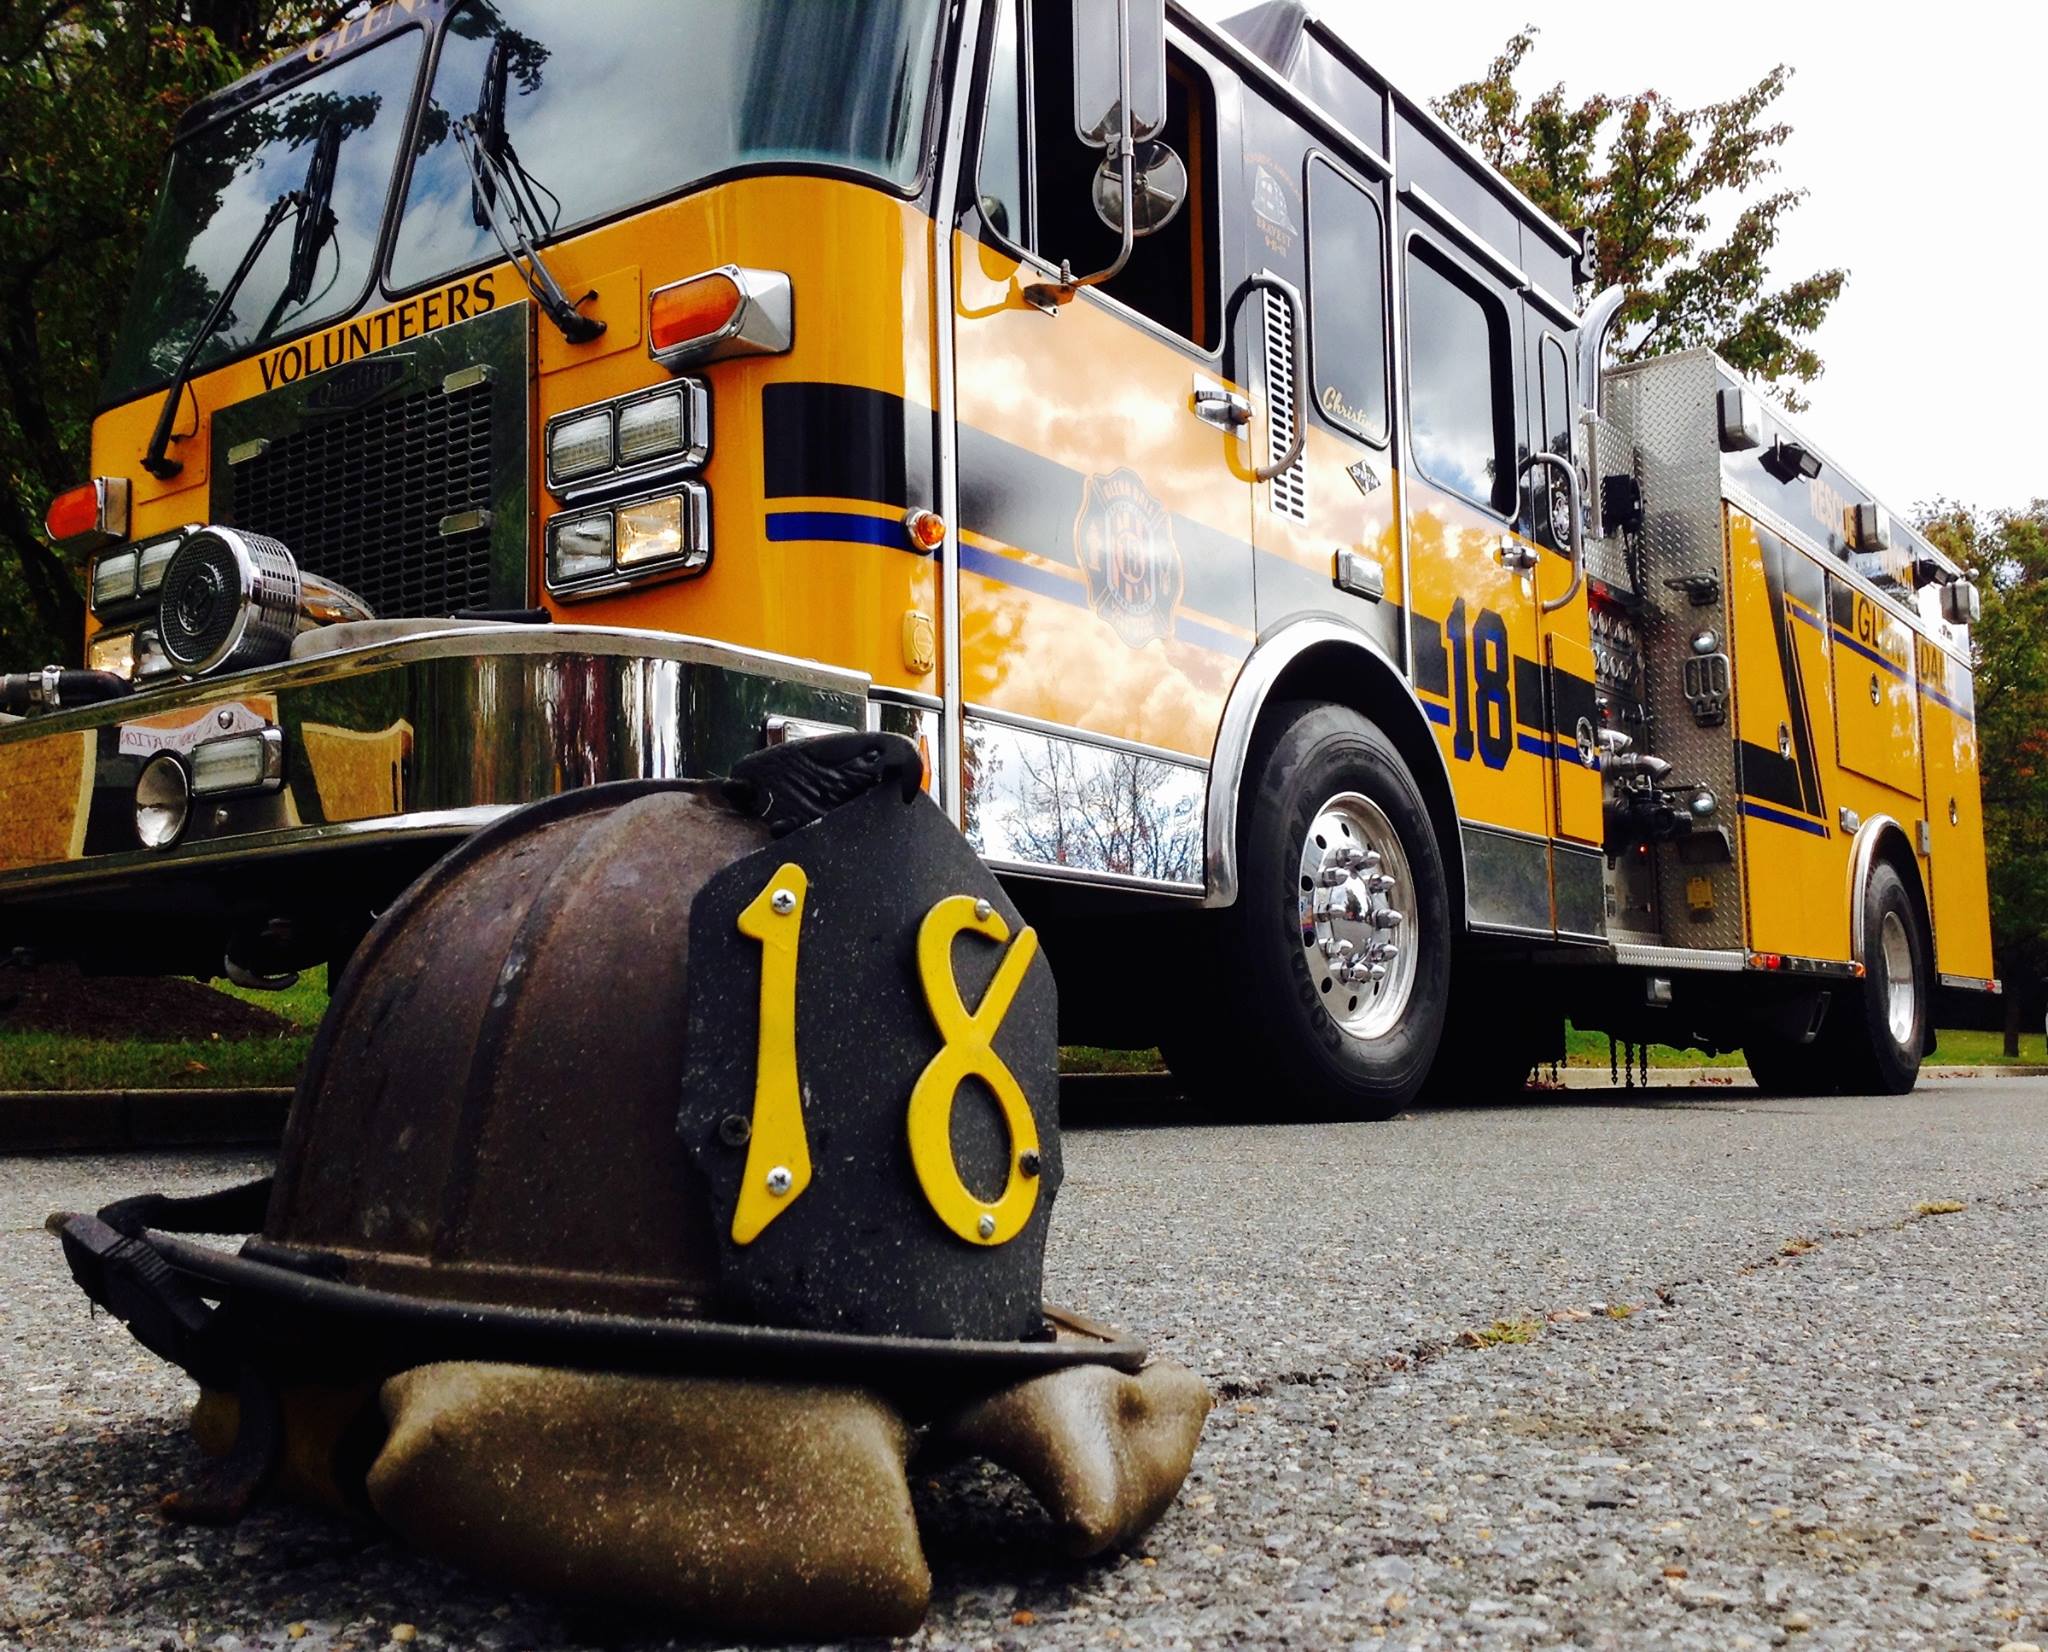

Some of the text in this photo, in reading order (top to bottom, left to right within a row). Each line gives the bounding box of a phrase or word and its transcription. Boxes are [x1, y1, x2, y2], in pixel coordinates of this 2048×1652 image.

[259, 273, 496, 391] VOLUNTEERS
[1323, 386, 1378, 432] Christine
[1446, 596, 1513, 771] 18
[731, 863, 1039, 1246] 18
